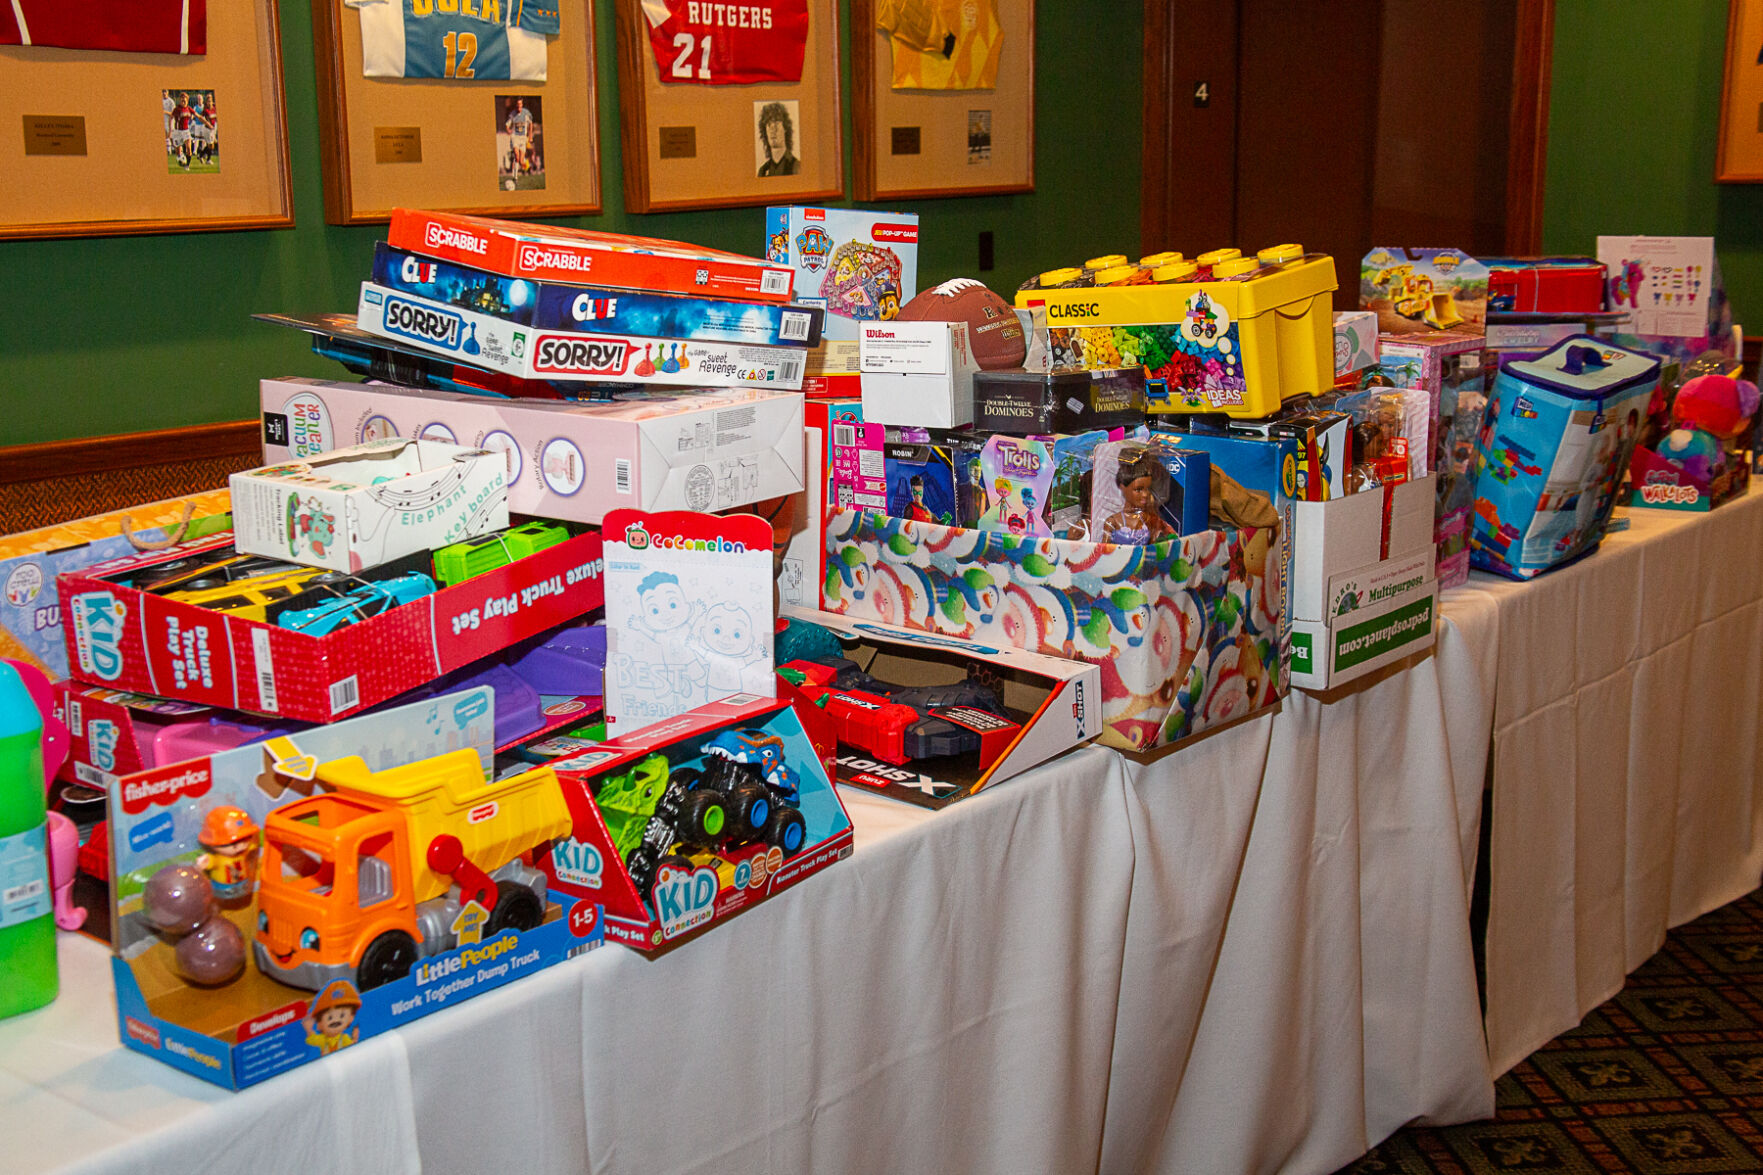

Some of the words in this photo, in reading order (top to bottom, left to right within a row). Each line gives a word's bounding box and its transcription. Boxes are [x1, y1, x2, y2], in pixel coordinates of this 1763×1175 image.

[687, 1, 772, 29] RUTGERS
[443, 32, 477, 79] 12
[672, 32, 712, 79] 21
[1195, 82, 1209, 101] 4
[427, 225, 488, 255] SCRABBLE
[795, 232, 835, 256] PAW
[401, 256, 438, 285] CLUE
[522, 250, 593, 272] SCRABBLE
[803, 255, 825, 264] PATROL
[571, 293, 618, 322] CLUE
[388, 302, 457, 343] SORRY!
[865, 329, 896, 339] Wilson
[540, 341, 624, 369] SORRY!
[699, 360, 737, 377] Revenge
[986, 399, 1032, 408] DOUBLE-TWELVE
[1094, 401, 1131, 414] DOMINOES
[1206, 389, 1242, 401] IDEAS
[983, 405, 1034, 418] DOMINOES
[892, 449, 913, 458] ROBIN
[997, 445, 1040, 471] Trolls
[401, 484, 468, 526] Elephant
[566, 557, 604, 585] eluxe
[521, 574, 565, 607] Truck
[1368, 575, 1424, 603] Multipurpose
[36, 605, 64, 631] BU
[483, 593, 519, 620] Play
[73, 598, 89, 668] Connection
[165, 615, 181, 656] Play
[451, 608, 481, 635] Set
[1339, 607, 1430, 656] pedrosplanet.com
[86, 597, 119, 676] KID
[182, 629, 200, 681] Truck
[195, 625, 213, 689] Deluxe
[172, 659, 188, 690] Set
[614, 653, 688, 699] BEST
[96, 723, 113, 770] KID
[125, 770, 208, 802] fisher-price
[554, 842, 601, 874] KID
[776, 867, 800, 885] Monster
[800, 859, 816, 873] Truck
[816, 854, 829, 865] Play
[828, 848, 838, 858] Set
[558, 871, 600, 886] Connection
[659, 872, 714, 924] KID
[463, 911, 478, 922] TRY
[573, 908, 594, 928] 1-5
[665, 909, 712, 937] Connection
[611, 926, 630, 940] Play
[630, 930, 645, 942] Set
[391, 994, 422, 1015] Work
[424, 976, 475, 1002] Together
[477, 963, 510, 984] Dump
[510, 949, 541, 969] Truck
[249, 1009, 296, 1034] Develops
